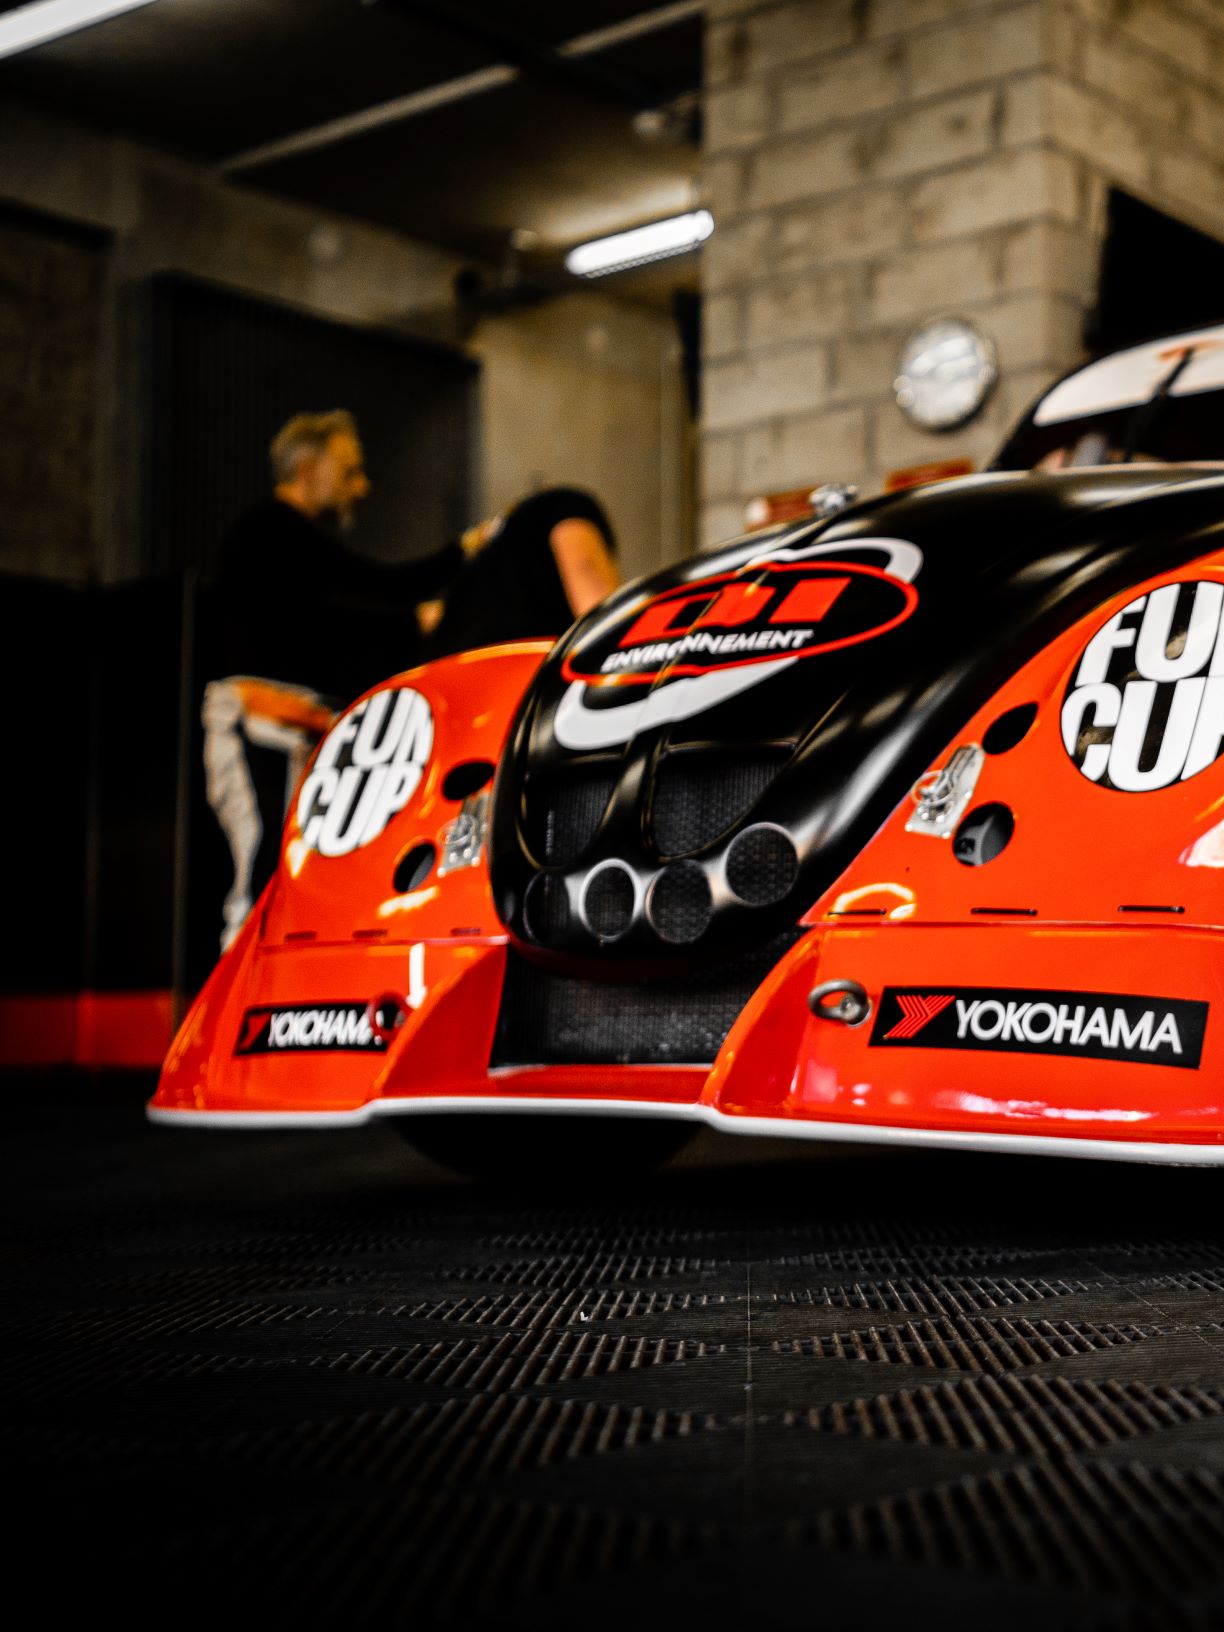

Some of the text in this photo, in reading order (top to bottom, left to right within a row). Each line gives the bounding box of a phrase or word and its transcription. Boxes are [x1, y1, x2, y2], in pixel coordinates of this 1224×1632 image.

[601, 629, 814, 673] ENVIRONNEMENT
[314, 687, 434, 769] FUN
[297, 762, 424, 857] CUP
[268, 1009, 385, 1047] YOKOHAM
[956, 1000, 1183, 1054] YOKOHAMA
